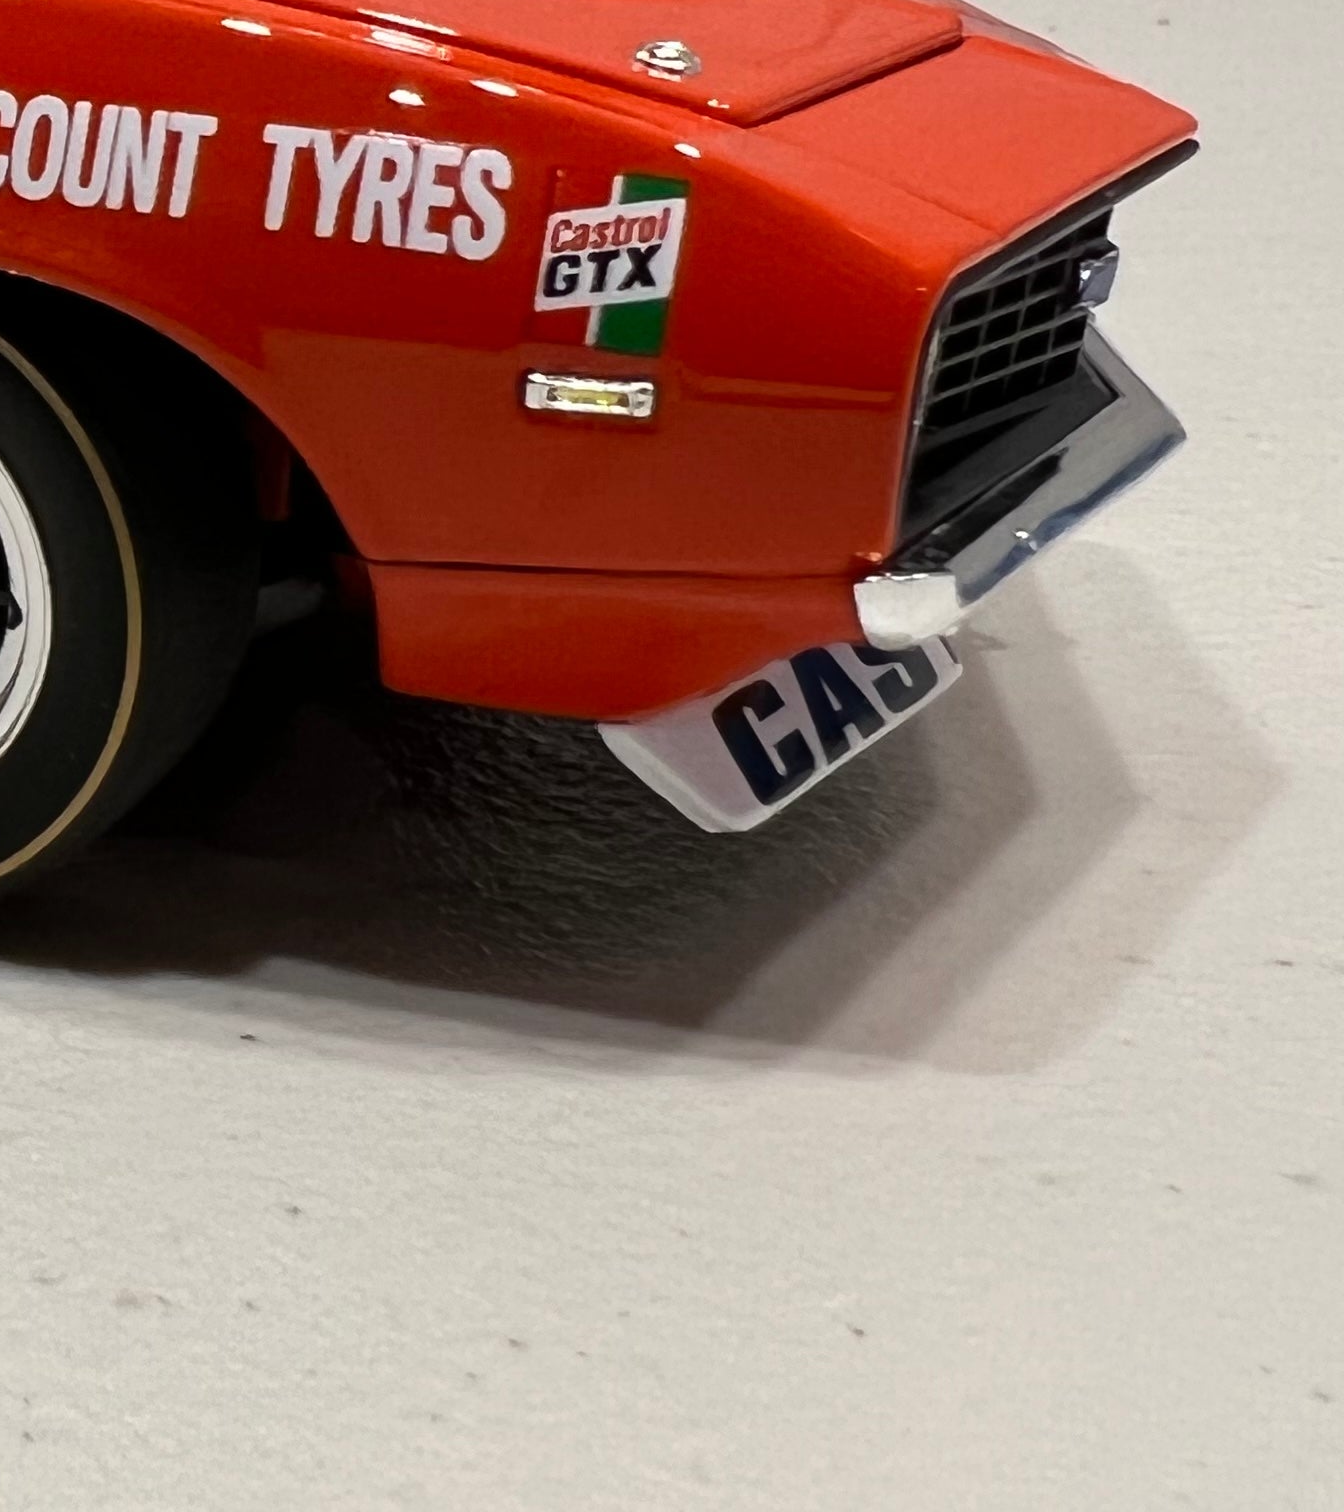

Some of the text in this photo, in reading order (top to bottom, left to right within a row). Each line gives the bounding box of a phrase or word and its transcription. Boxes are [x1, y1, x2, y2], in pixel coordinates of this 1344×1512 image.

[263, 123, 512, 261] TYRES
[550, 206, 671, 254] Castrol
[542, 242, 663, 298] GTX
